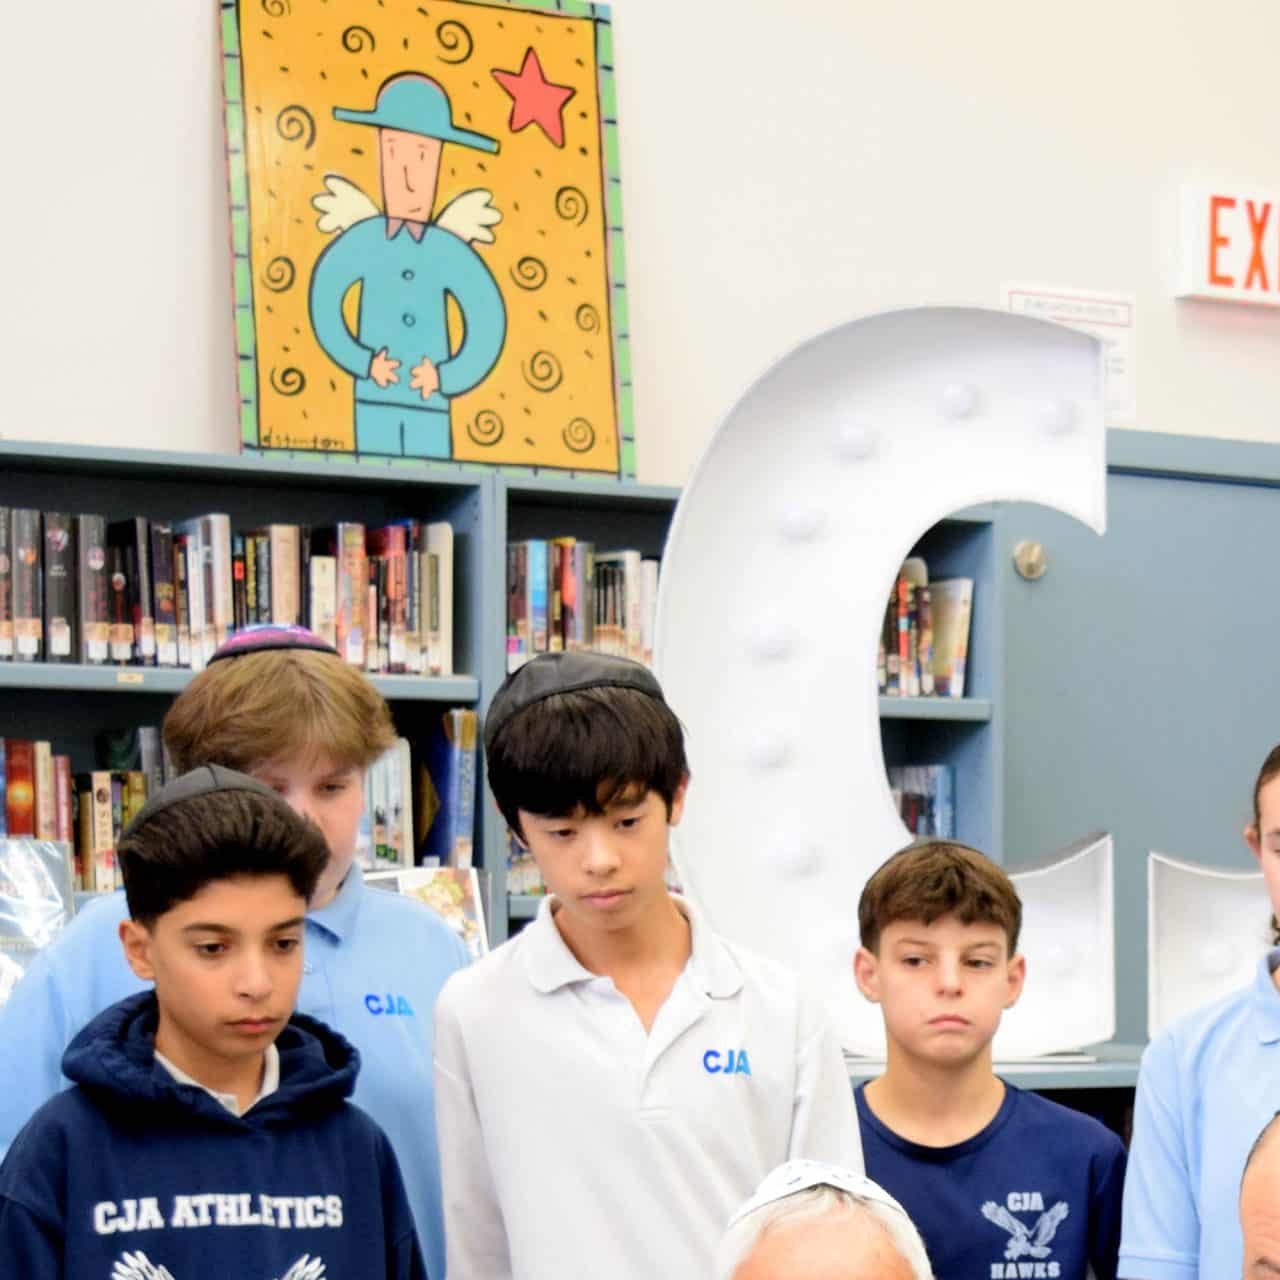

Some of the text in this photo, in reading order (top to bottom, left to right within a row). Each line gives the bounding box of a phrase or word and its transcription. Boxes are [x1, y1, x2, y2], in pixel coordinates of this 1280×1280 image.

[364, 993, 415, 1017] CJA
[703, 1048, 753, 1076] CJA
[1007, 1191, 1045, 1211] CJA
[93, 1193, 344, 1235] CJA ATHLETICS
[990, 1260, 1061, 1280] HAWKS
